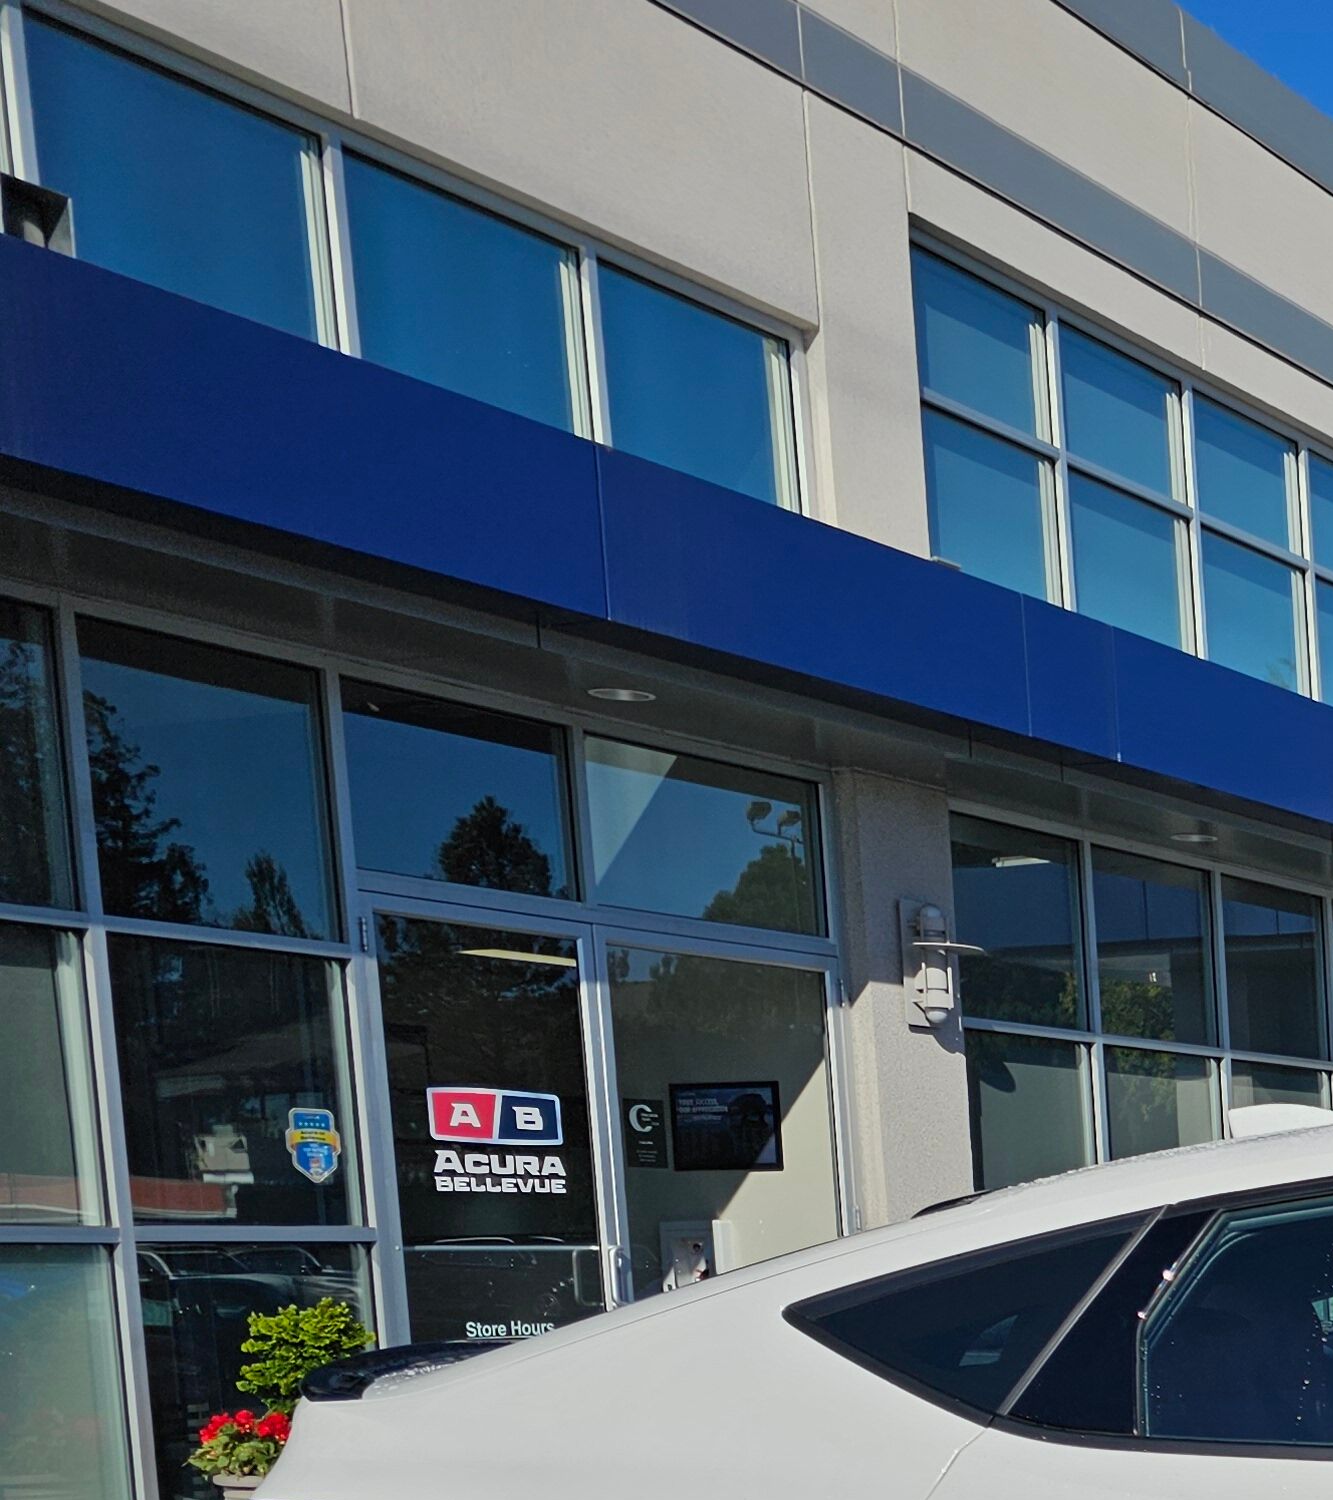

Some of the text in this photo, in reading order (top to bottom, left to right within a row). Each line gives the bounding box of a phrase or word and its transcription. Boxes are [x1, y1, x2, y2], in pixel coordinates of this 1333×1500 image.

[450, 1103, 543, 1131] A B
[434, 1150, 567, 1176] ACURA
[434, 1176, 567, 1194] BELLEVUE
[465, 1320, 555, 1338] Store Hours
